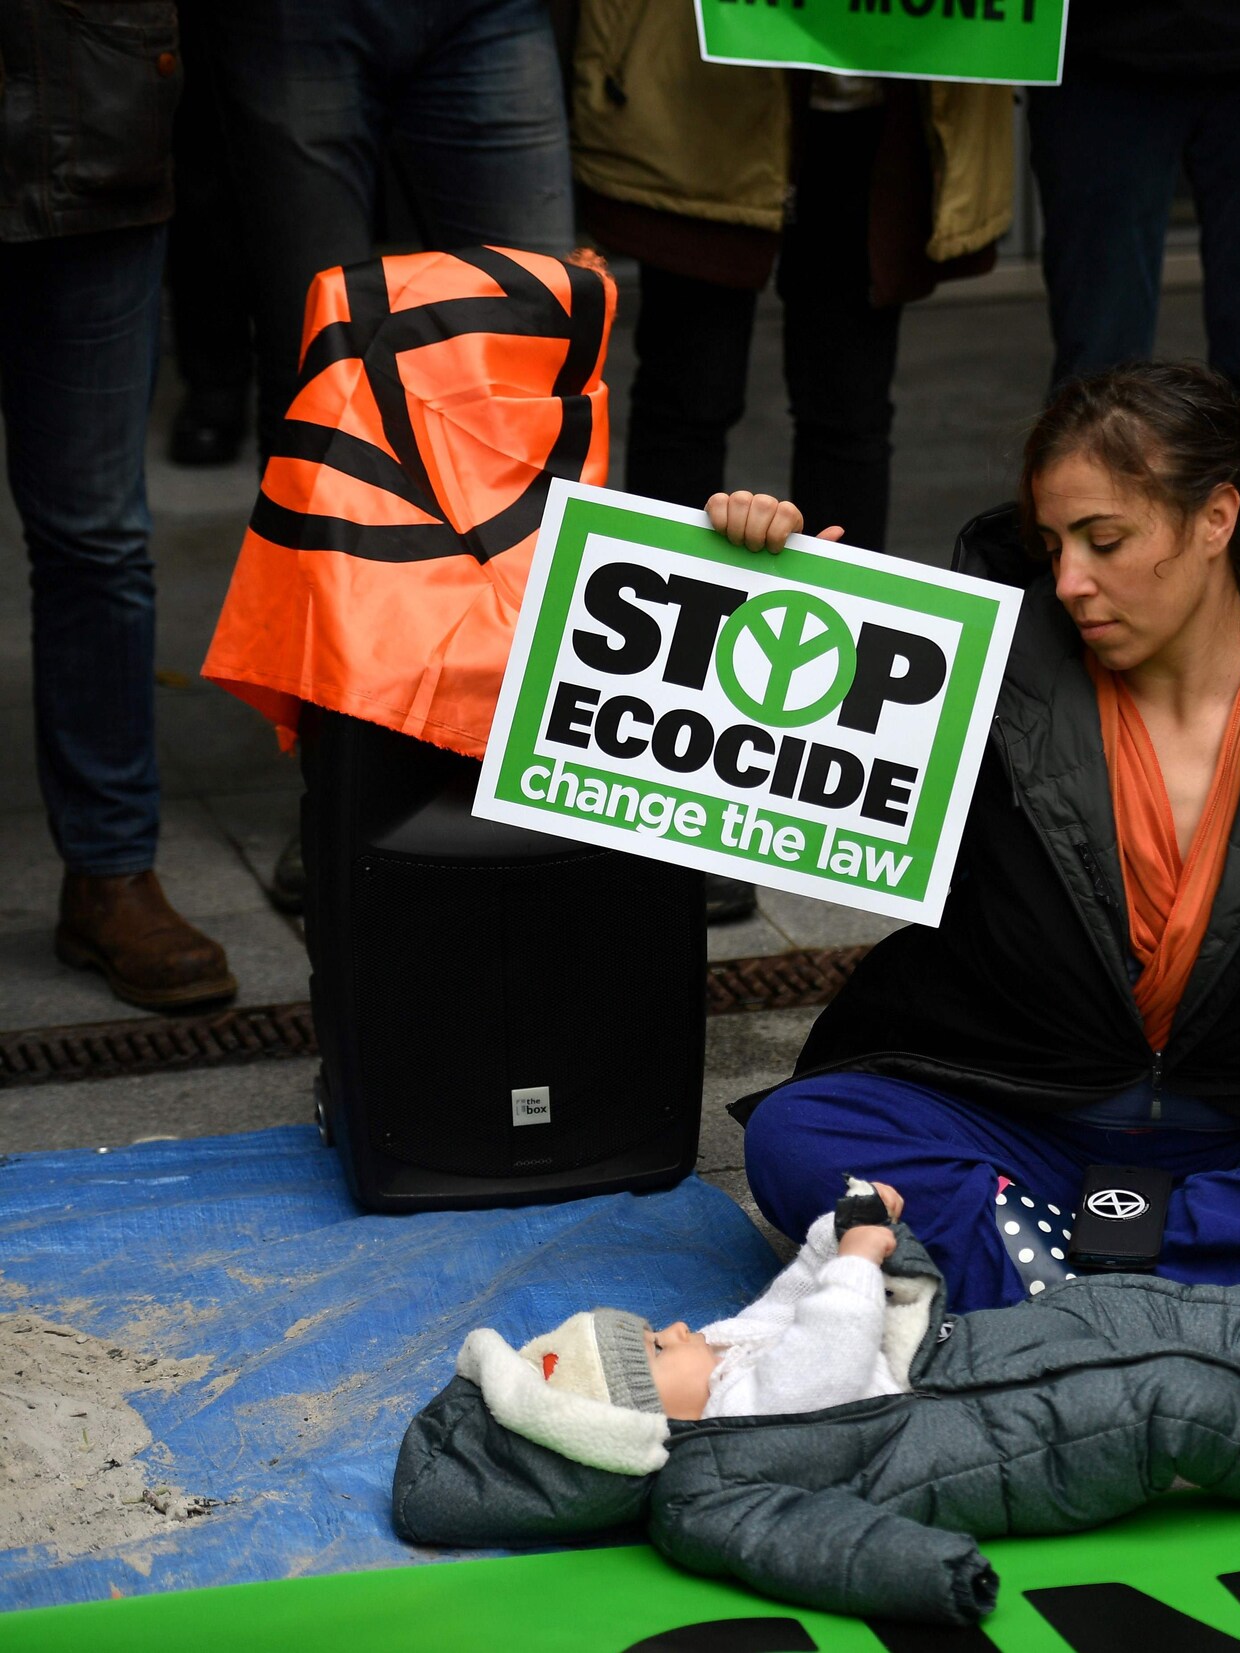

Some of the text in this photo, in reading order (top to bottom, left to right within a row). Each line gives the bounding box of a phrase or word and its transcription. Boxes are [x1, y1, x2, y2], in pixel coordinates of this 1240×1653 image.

[572, 561, 947, 735] STOP
[545, 681, 919, 828] ECOCIDE
[520, 761, 913, 887] change the law
[526, 1105, 547, 1115] box
